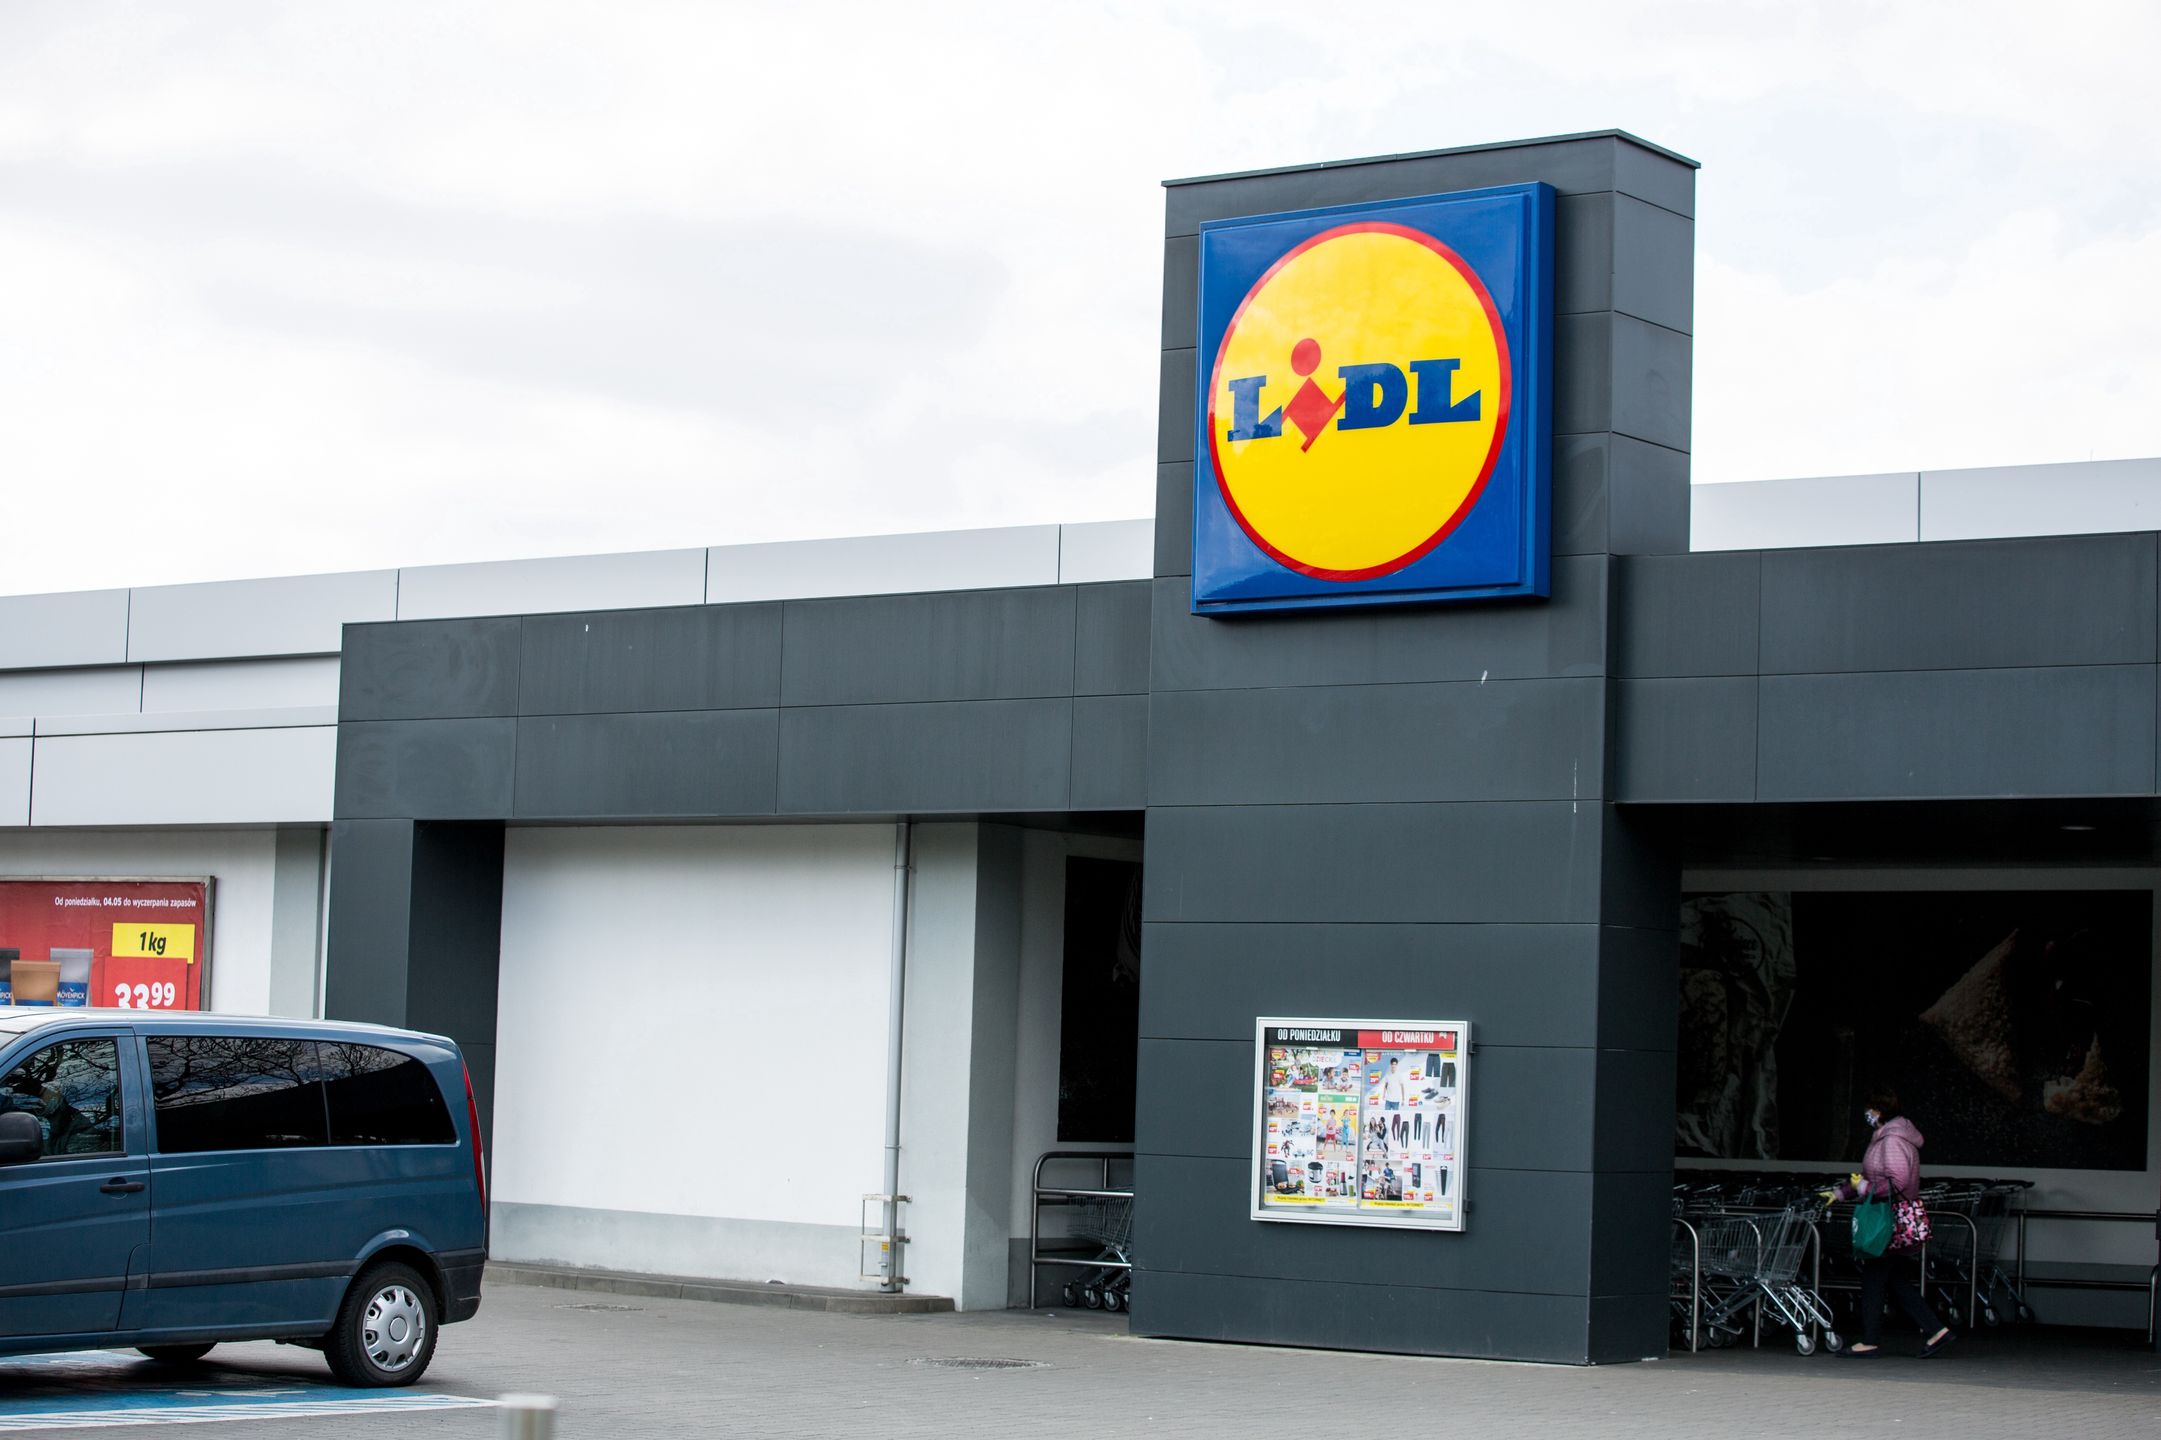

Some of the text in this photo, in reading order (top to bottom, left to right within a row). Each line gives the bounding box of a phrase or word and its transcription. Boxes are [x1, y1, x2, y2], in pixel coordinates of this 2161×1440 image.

[54, 896, 197, 909] Od poniedziałku, 04.05 do wyczerpania zapasów
[1277, 1028, 1341, 1042] OD PONIEDZIAŁKU
[1381, 1031, 1434, 1044] OD CZWARTKU
